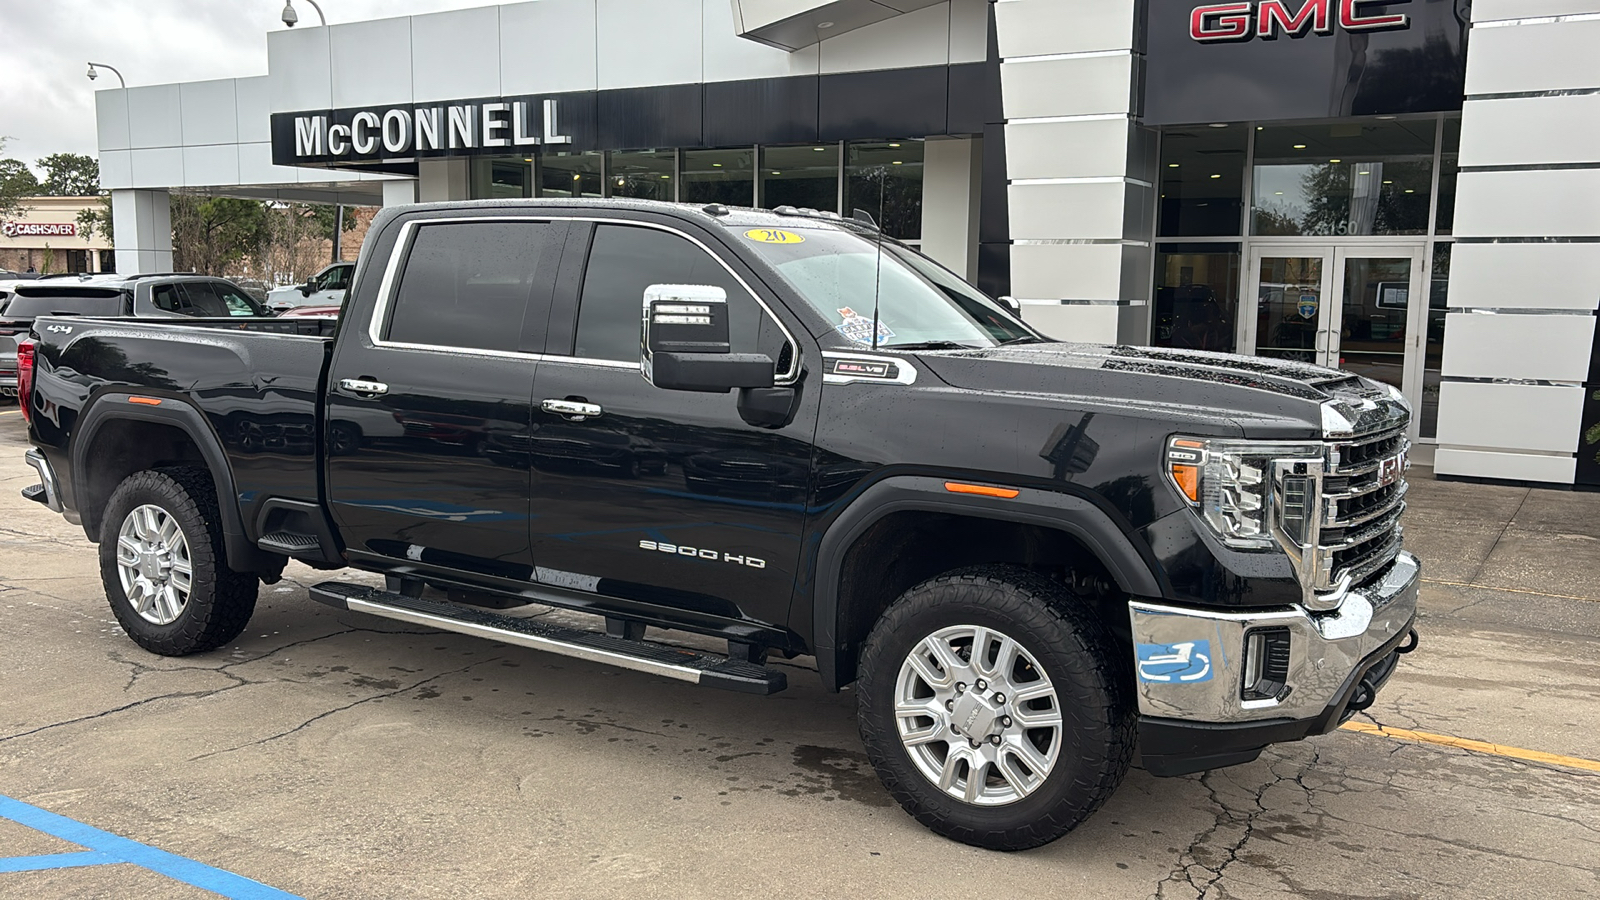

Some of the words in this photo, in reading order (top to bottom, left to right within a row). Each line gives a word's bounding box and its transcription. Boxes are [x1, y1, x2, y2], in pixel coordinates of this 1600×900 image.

[1190, 0, 1408, 42] GMC
[294, 99, 572, 156] McCONNELL
[760, 230, 787, 242] 20
[724, 552, 766, 569] HD
